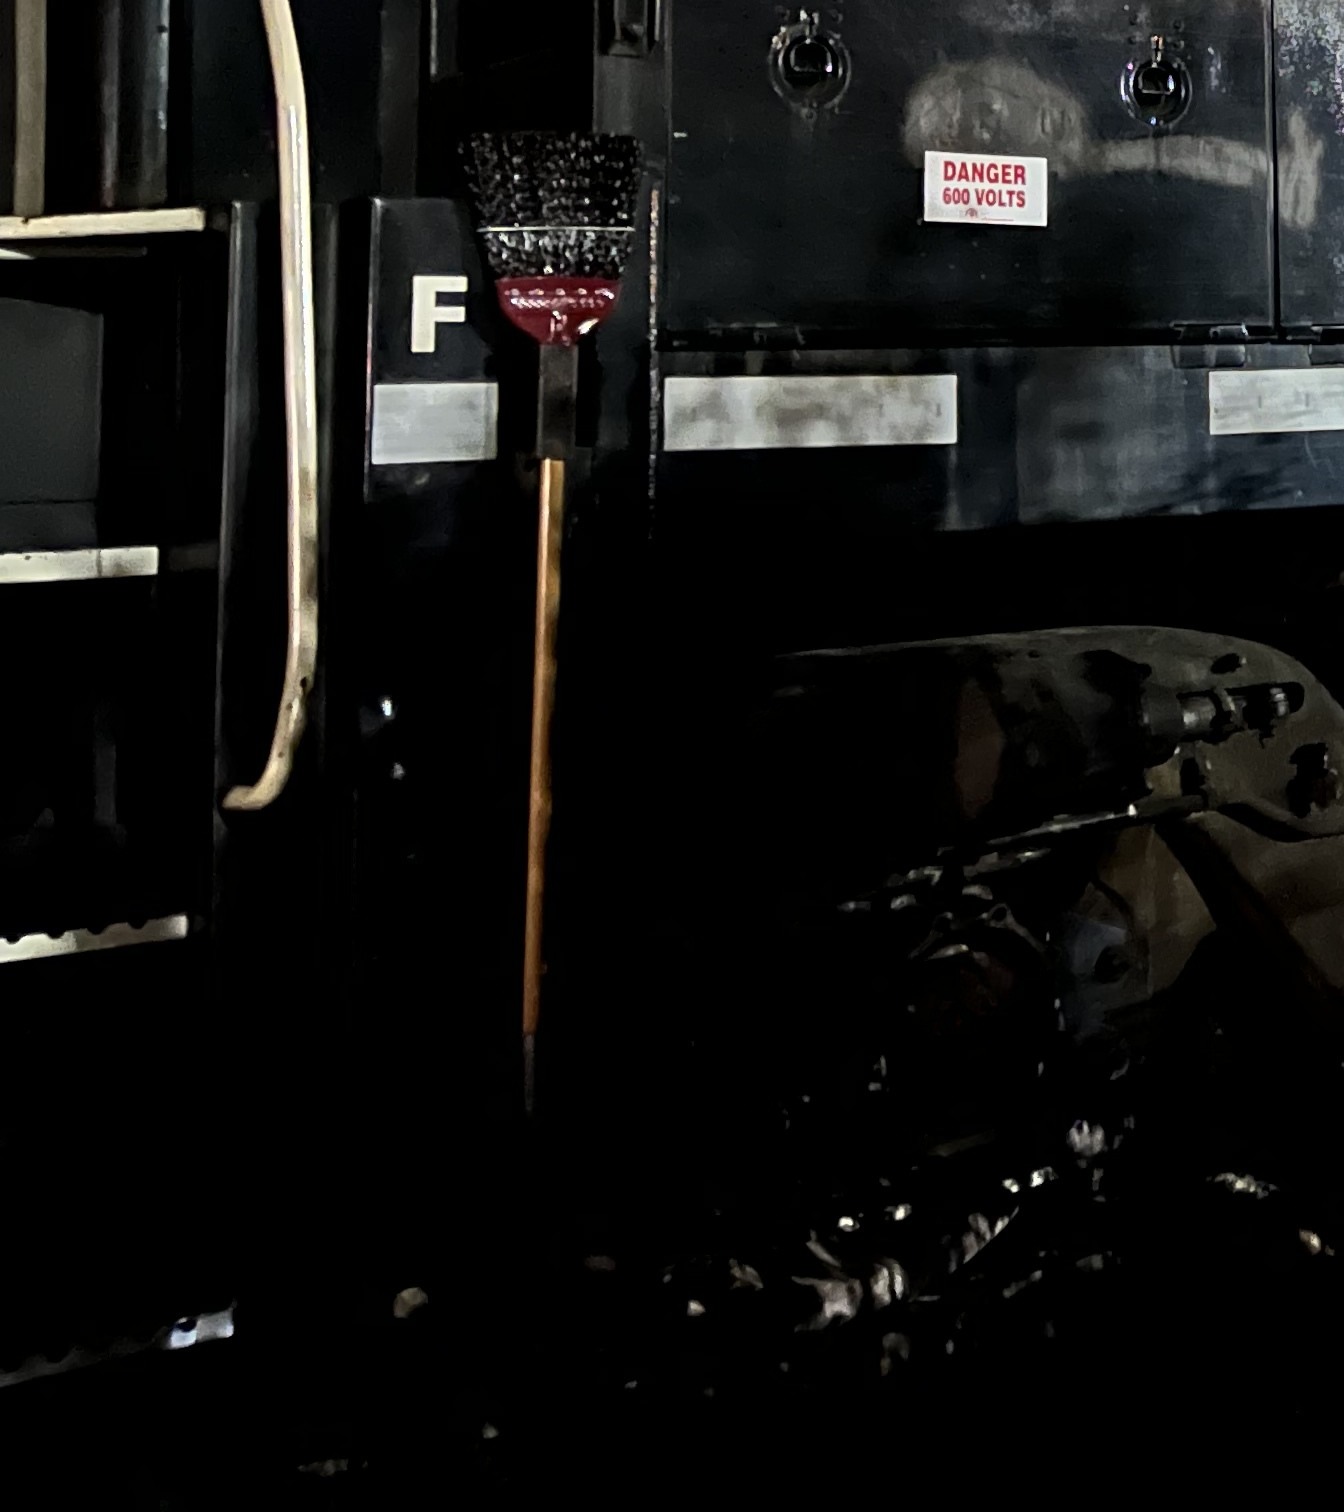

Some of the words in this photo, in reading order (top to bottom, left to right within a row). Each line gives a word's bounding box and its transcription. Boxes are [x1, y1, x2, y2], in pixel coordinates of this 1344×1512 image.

[943, 160, 1027, 185] DANGER
[943, 187, 970, 205] 600
[974, 188, 1026, 208] VOLTS
[410, 275, 469, 353] F
